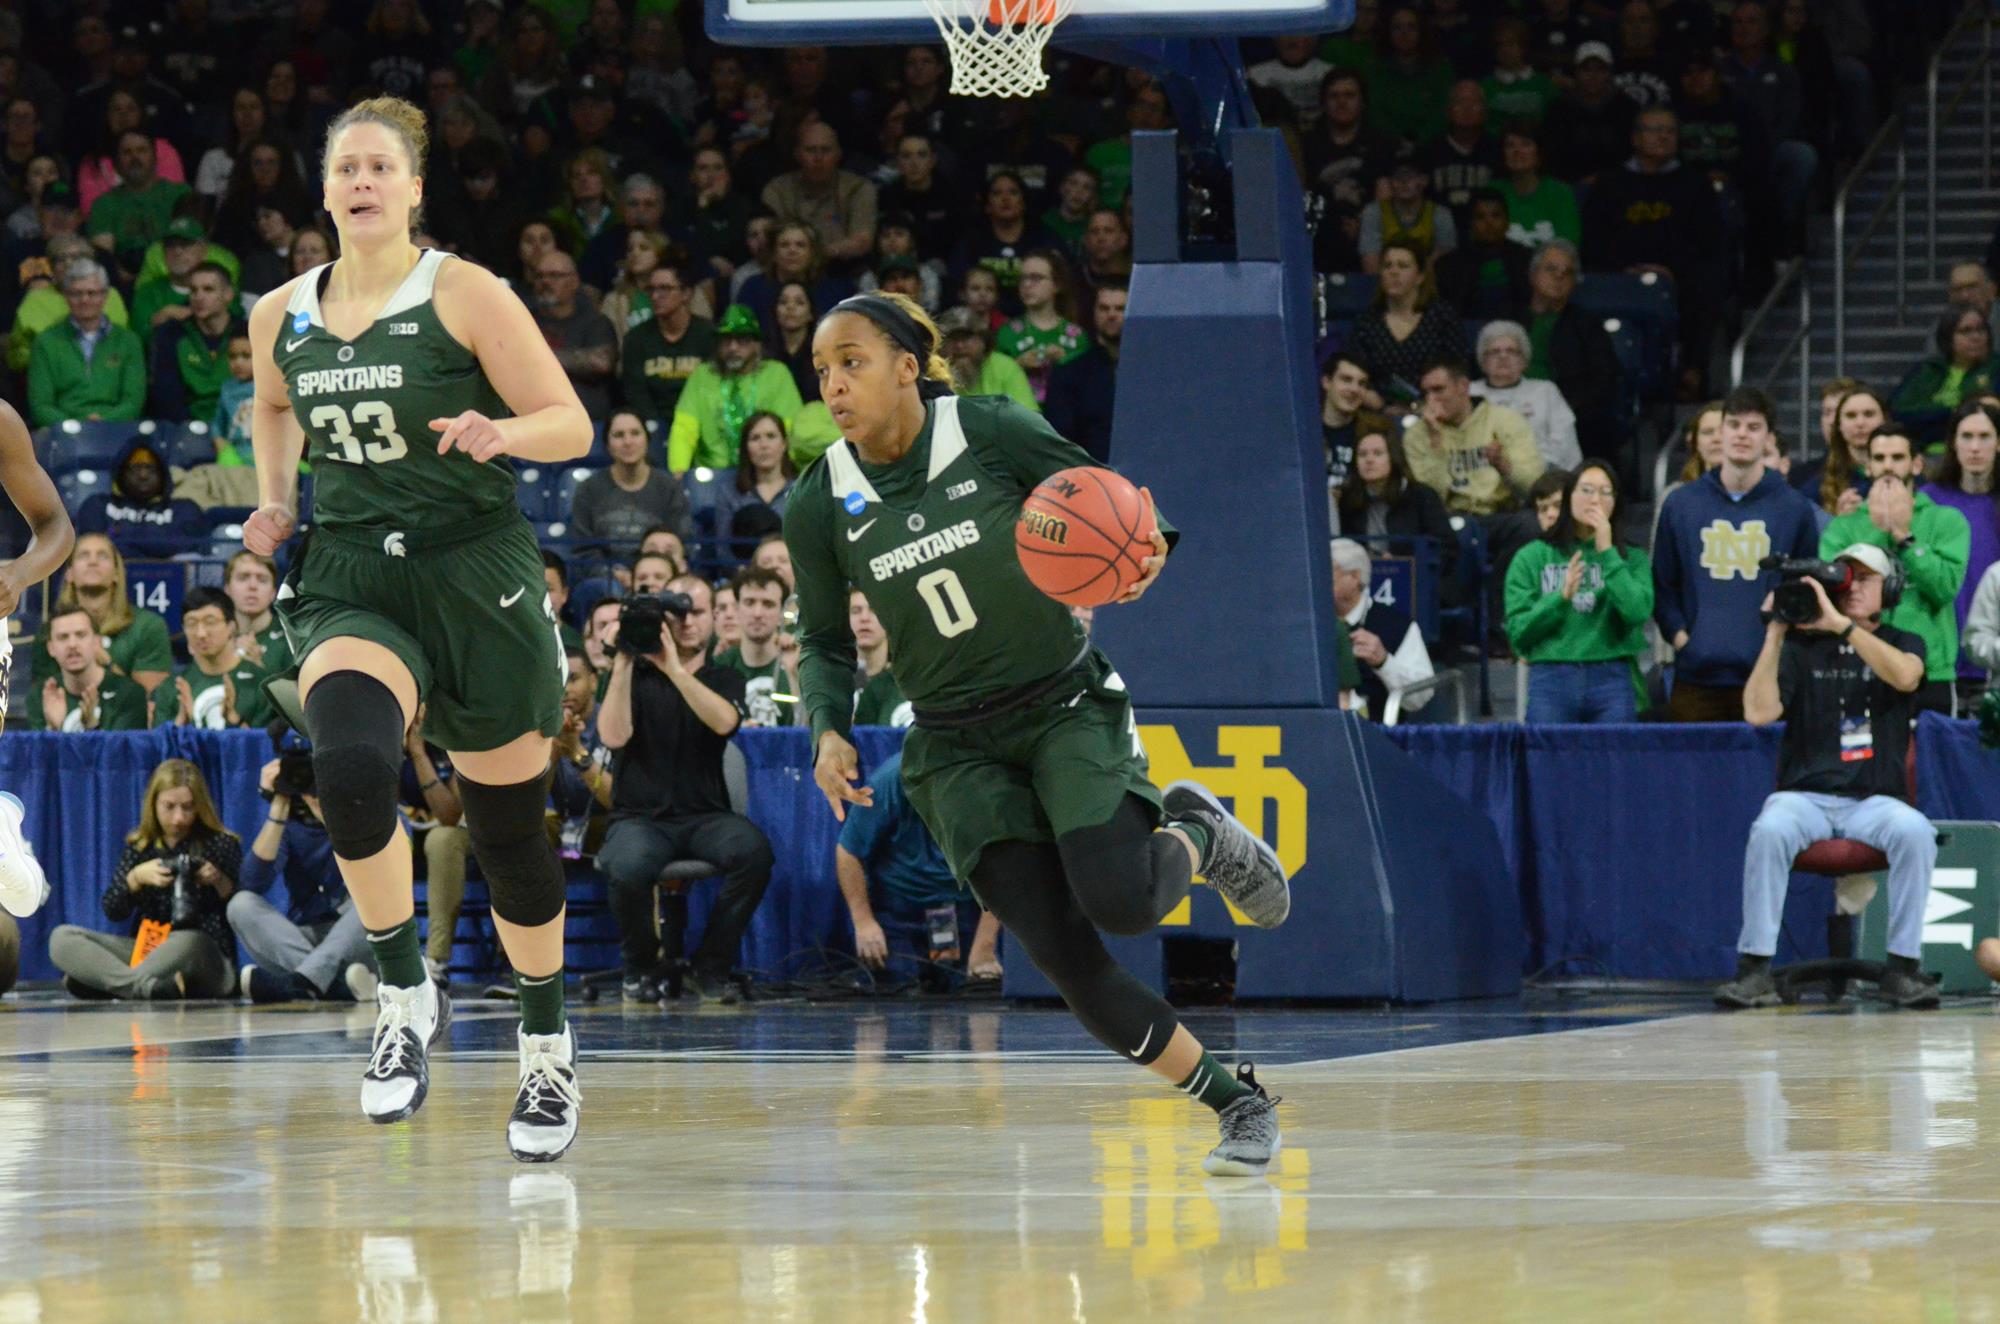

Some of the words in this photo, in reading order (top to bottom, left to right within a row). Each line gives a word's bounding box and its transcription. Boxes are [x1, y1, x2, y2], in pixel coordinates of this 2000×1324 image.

[297, 365, 403, 397] SPARTANS
[310, 401, 408, 465] 33
[869, 520, 981, 582] SPARTANS
[134, 580, 170, 614] 14
[917, 567, 978, 638] 0
